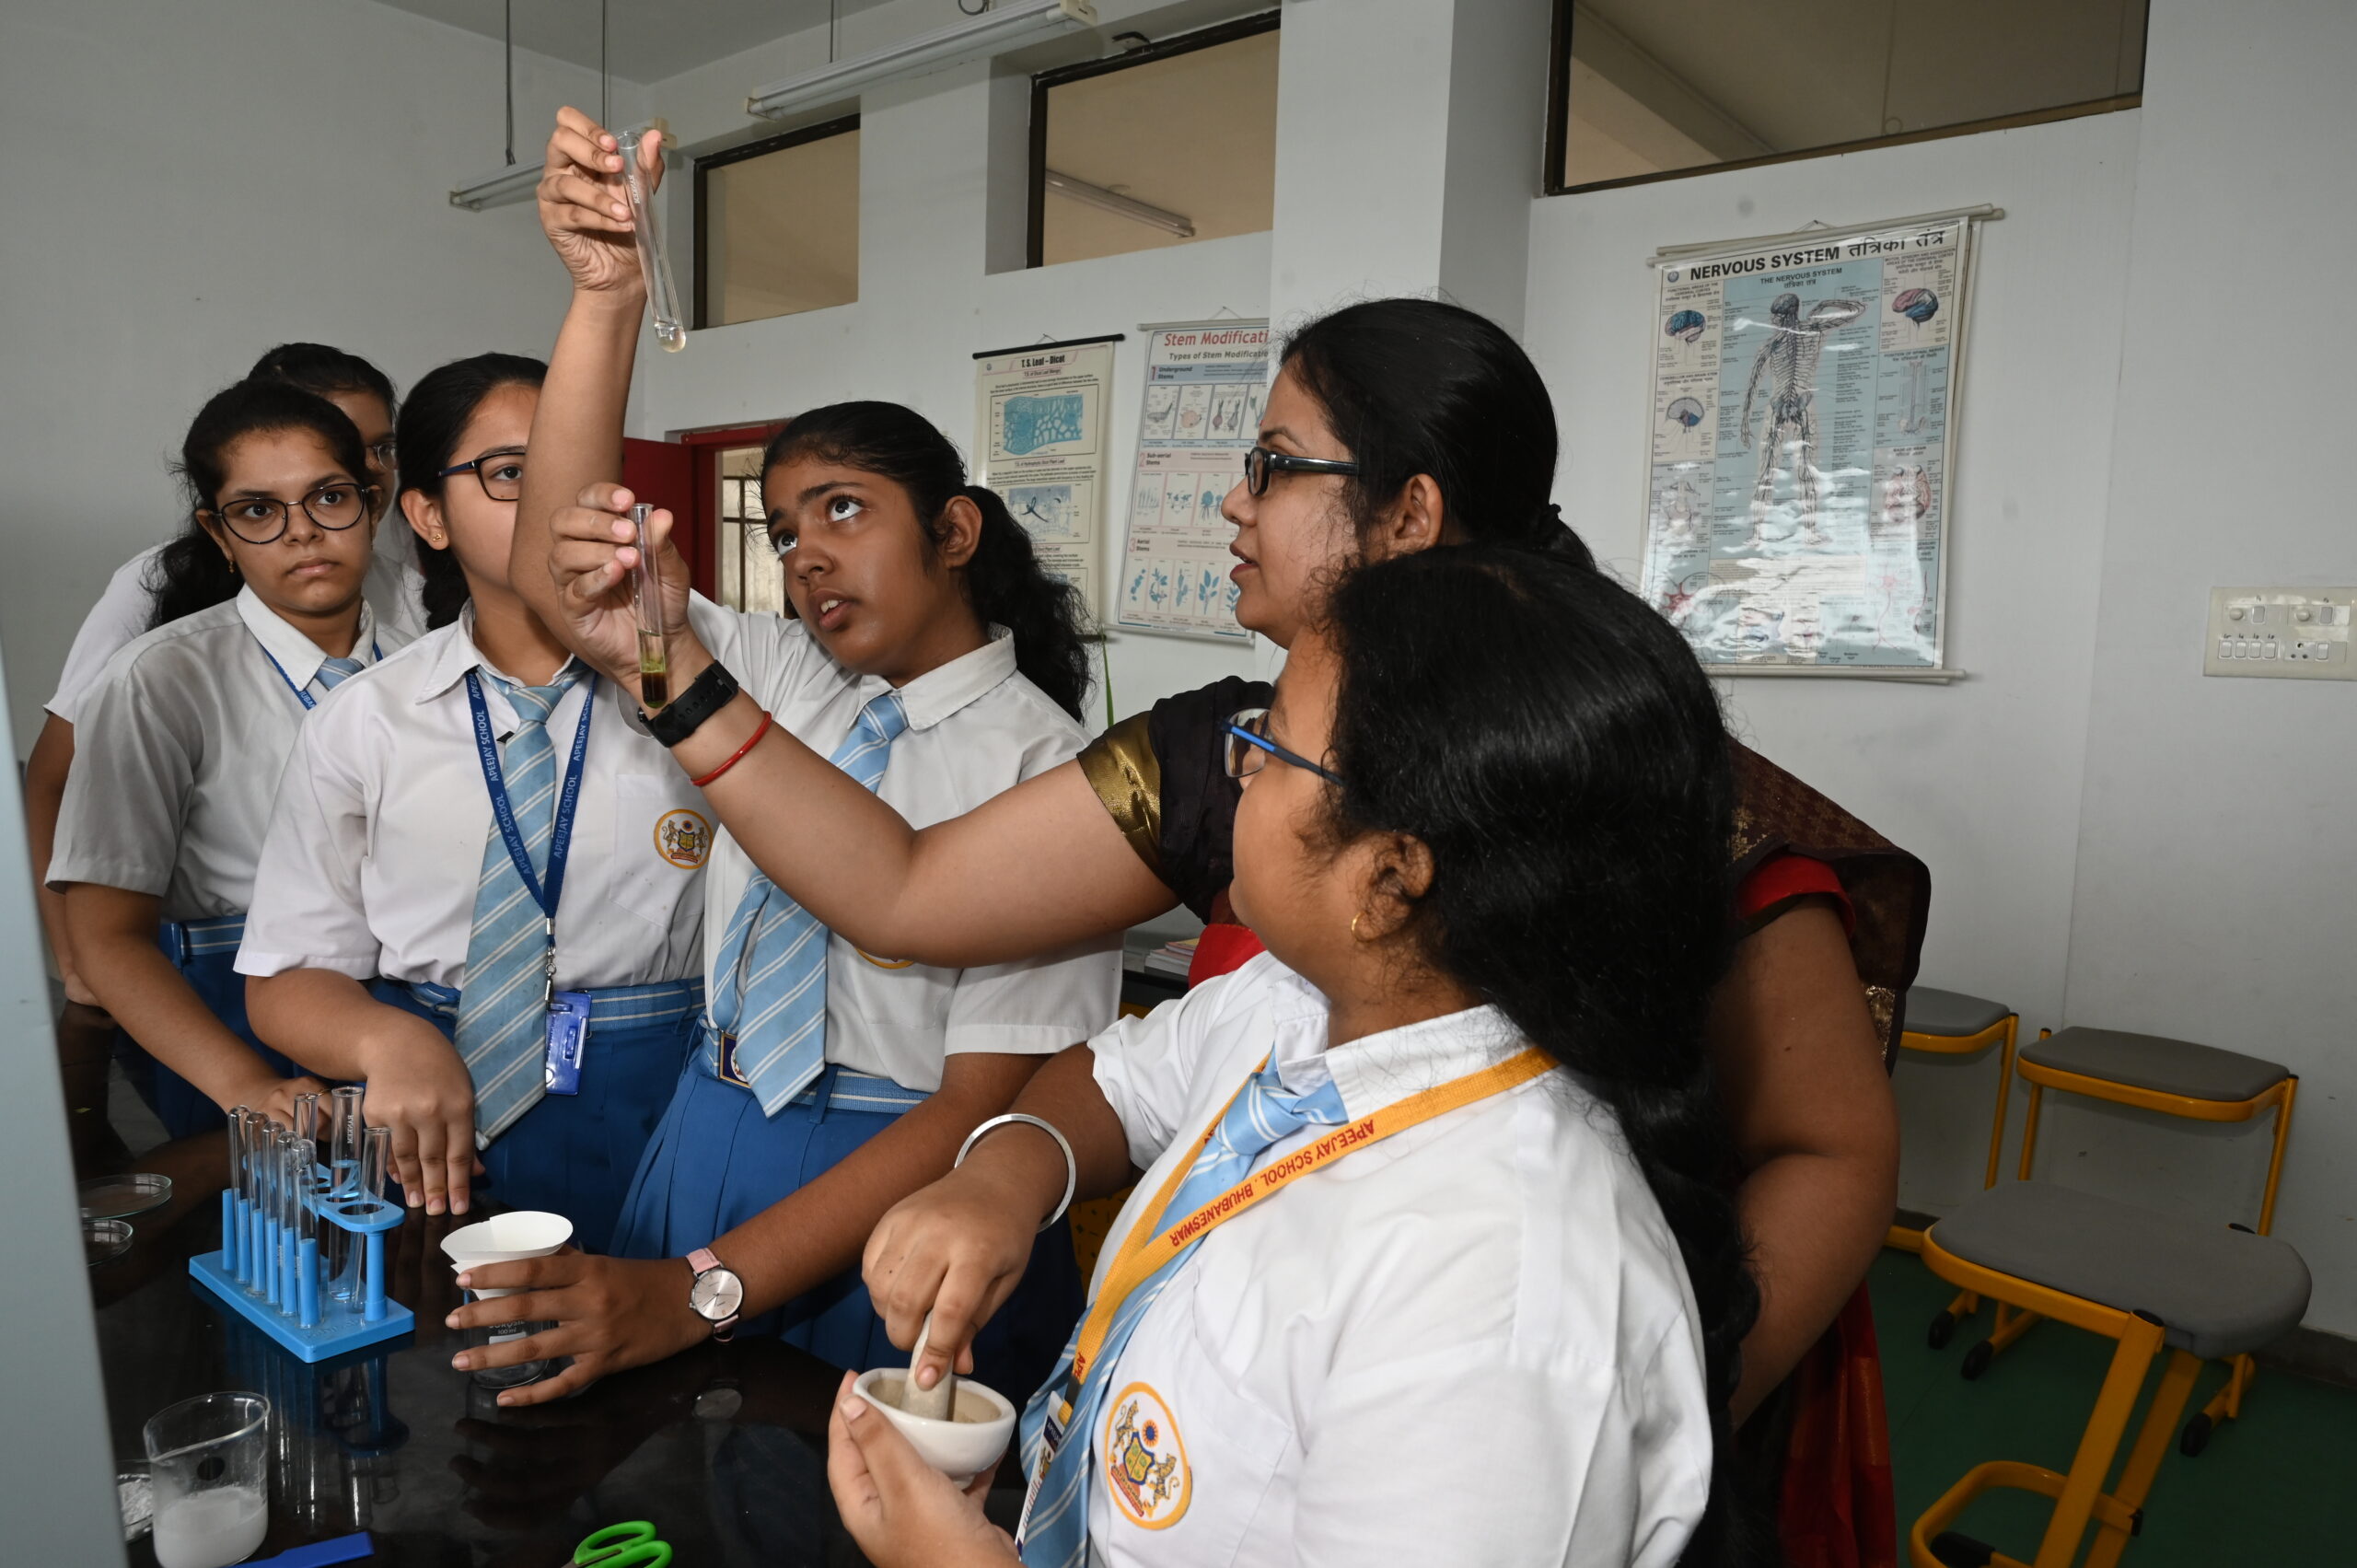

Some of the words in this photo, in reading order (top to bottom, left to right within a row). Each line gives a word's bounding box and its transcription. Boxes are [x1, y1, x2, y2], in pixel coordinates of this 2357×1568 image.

[1916, 228, 1945, 248] तंत्र
[1690, 258, 1765, 281] NERVOUS
[1771, 246, 1840, 269] SYSTEM
[1760, 277, 1773, 285] THE
[1776, 272, 1811, 283] NERVOUS
[1812, 267, 1842, 278] SYSTEM
[1165, 333, 1196, 346] Stem
[1201, 330, 1268, 345] Modificati
[1169, 353, 1190, 361] Types
[1202, 351, 1222, 359] Stem
[1225, 349, 1268, 359] Modificatio
[1032, 356, 1044, 367] Leaf
[1050, 354, 1065, 365] Dicot
[476, 709, 491, 745] SCHOOL
[574, 724, 586, 761] APEEJAY
[483, 746, 499, 782] APEEJAY
[495, 793, 514, 833] SCHOOL
[553, 816, 569, 859] APEEJAY
[562, 774, 578, 815] SCHOOL
[508, 835, 532, 875] APEEJAY
[1316, 1119, 1376, 1160] APEEJAY
[1260, 1150, 1314, 1187] SCHOOL
[1169, 1183, 1254, 1248] BHUBANESWAR
